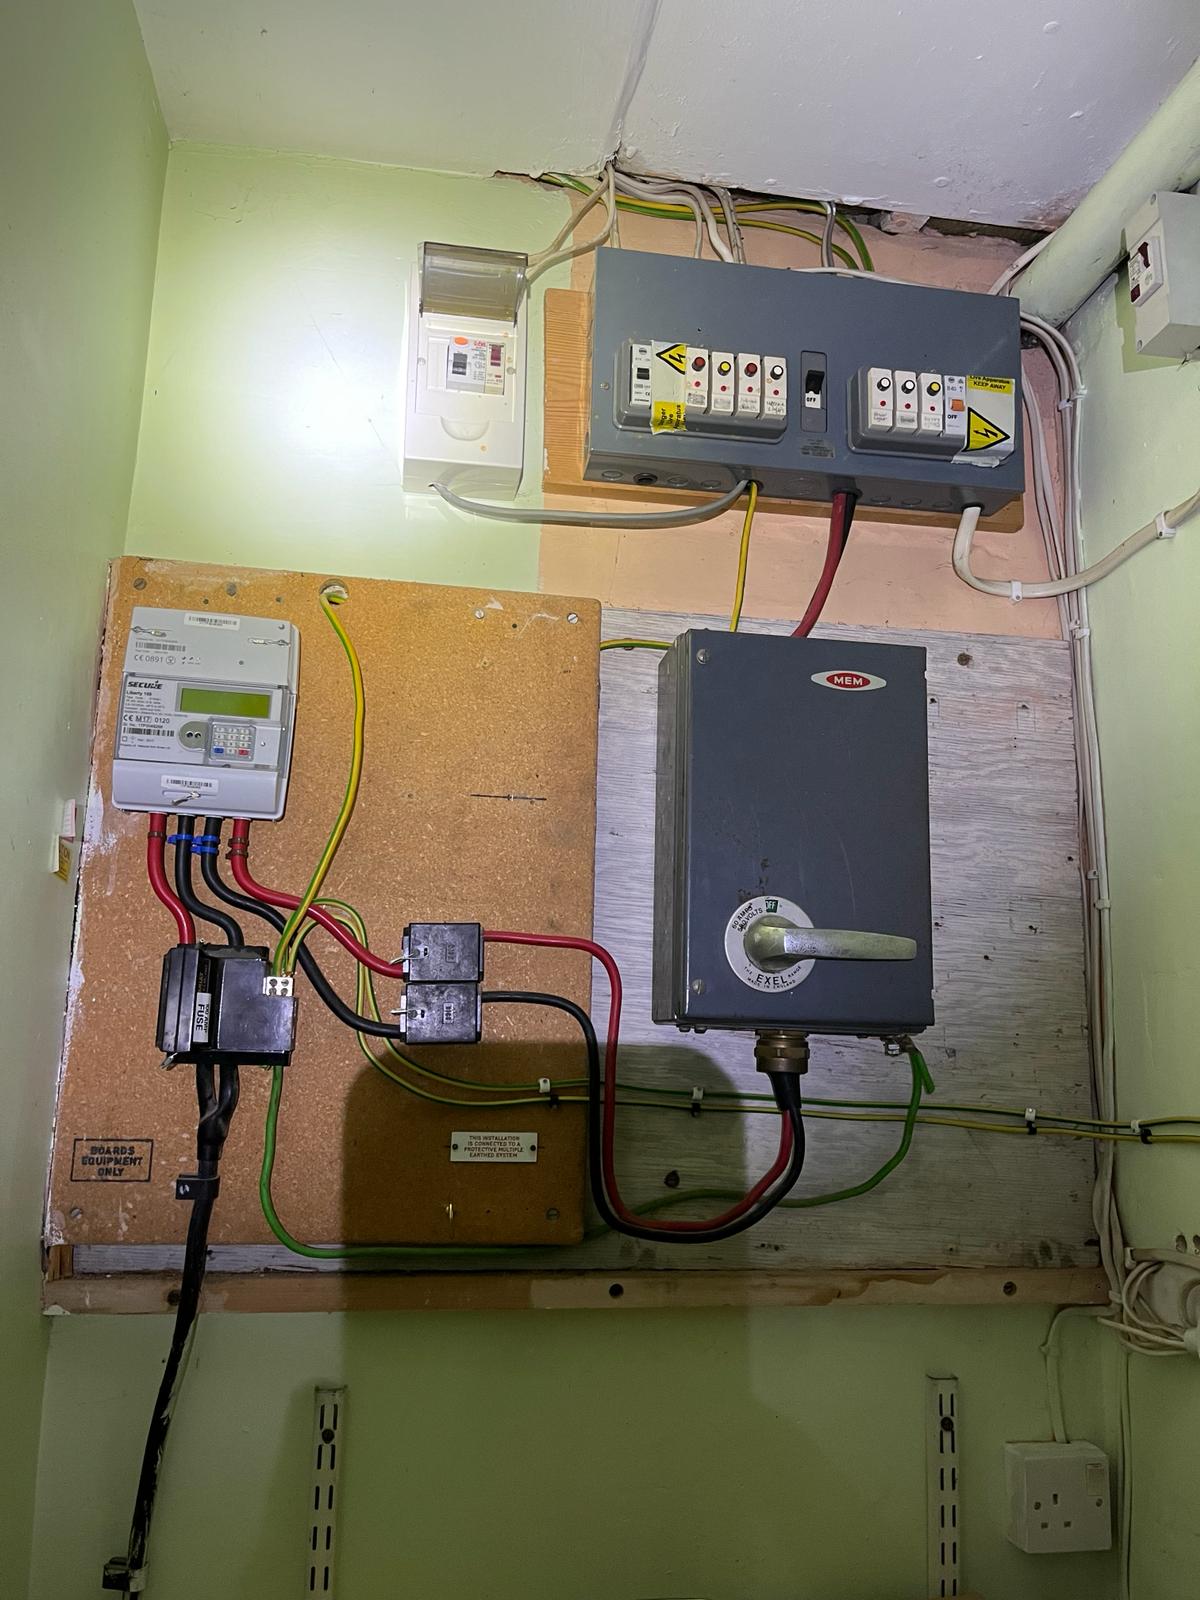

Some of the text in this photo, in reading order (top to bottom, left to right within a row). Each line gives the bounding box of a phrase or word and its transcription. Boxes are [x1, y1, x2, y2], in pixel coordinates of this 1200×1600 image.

[990, 382, 1006, 390] AWAY
[145, 655, 163, 663] 0891
[128, 680, 163, 690] SECURE
[834, 676, 863, 686] MEM
[744, 907, 763, 921] VOLTS
[756, 974, 787, 986] EXEL
[195, 1003, 205, 1031] FUSE
[90, 1146, 135, 1155] BOARDS
[81, 1156, 143, 1166] EQUIPMENT
[97, 1167, 124, 1177] ONLY
